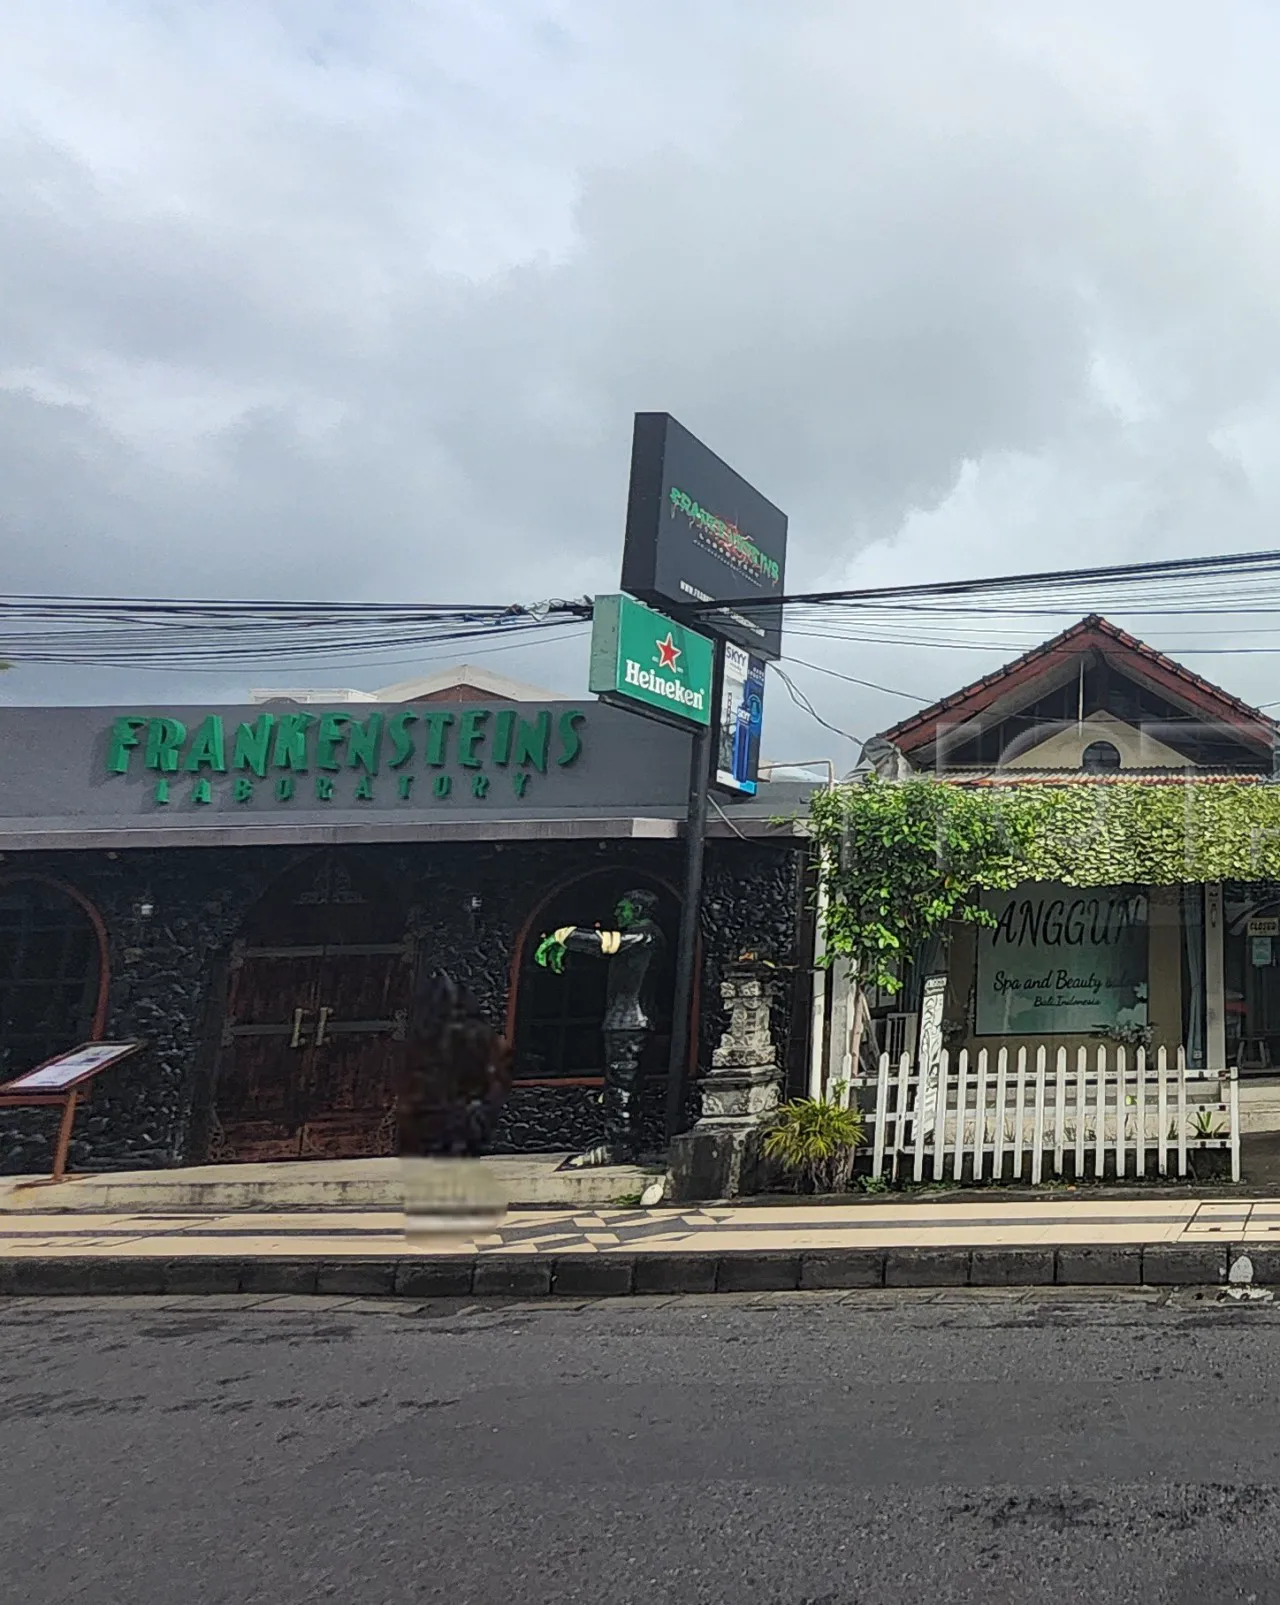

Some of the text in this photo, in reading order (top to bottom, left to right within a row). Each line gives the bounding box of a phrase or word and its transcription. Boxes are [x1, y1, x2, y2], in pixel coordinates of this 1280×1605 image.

[726, 646, 747, 667] SKYY
[625, 659, 703, 710] Heineken
[106, 710, 586, 777] FRANKENSTEINS
[154, 772, 531, 804] LABORATORY
[993, 970, 1021, 995] Spa
[1024, 970, 1053, 989] and
[1056, 969, 1103, 994] Beauty
